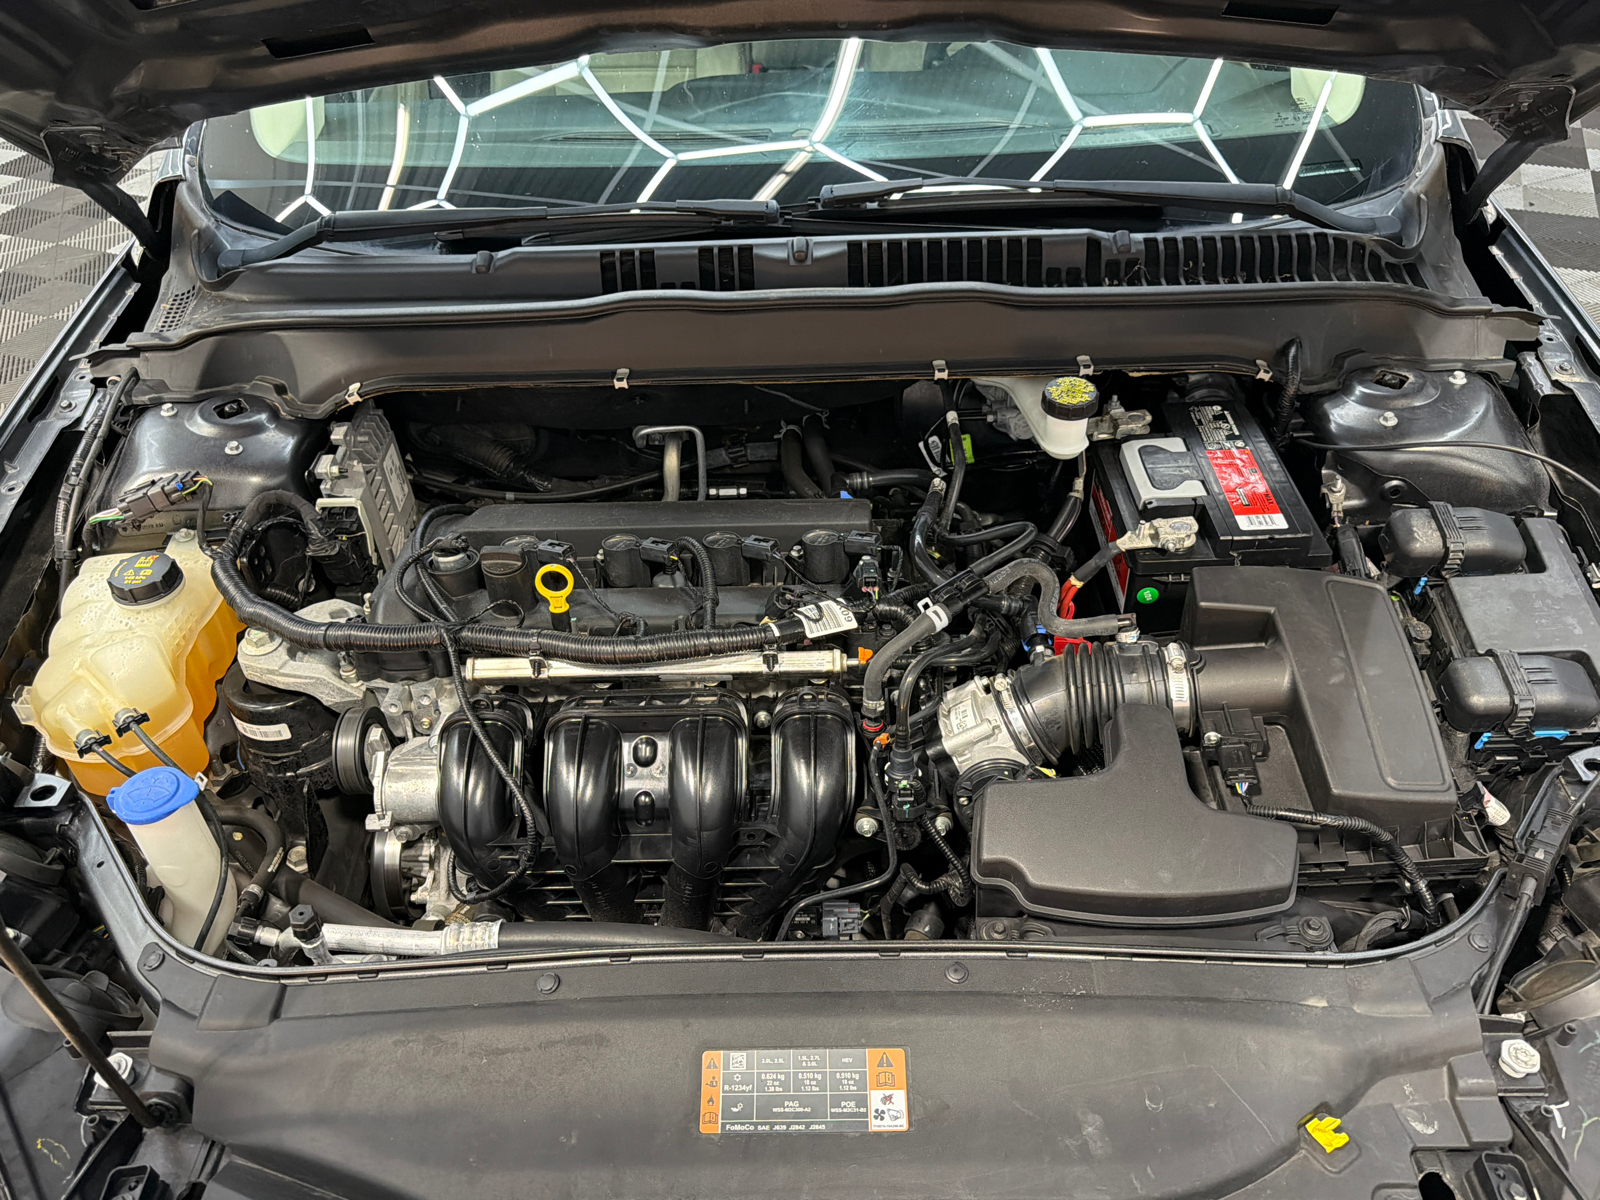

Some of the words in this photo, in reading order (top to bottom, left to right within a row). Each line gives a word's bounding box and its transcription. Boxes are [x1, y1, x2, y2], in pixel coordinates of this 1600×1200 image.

[777, 1073, 785, 1081] kg
[852, 1072, 860, 1080] kg
[724, 1084, 753, 1093] R-1234yf
